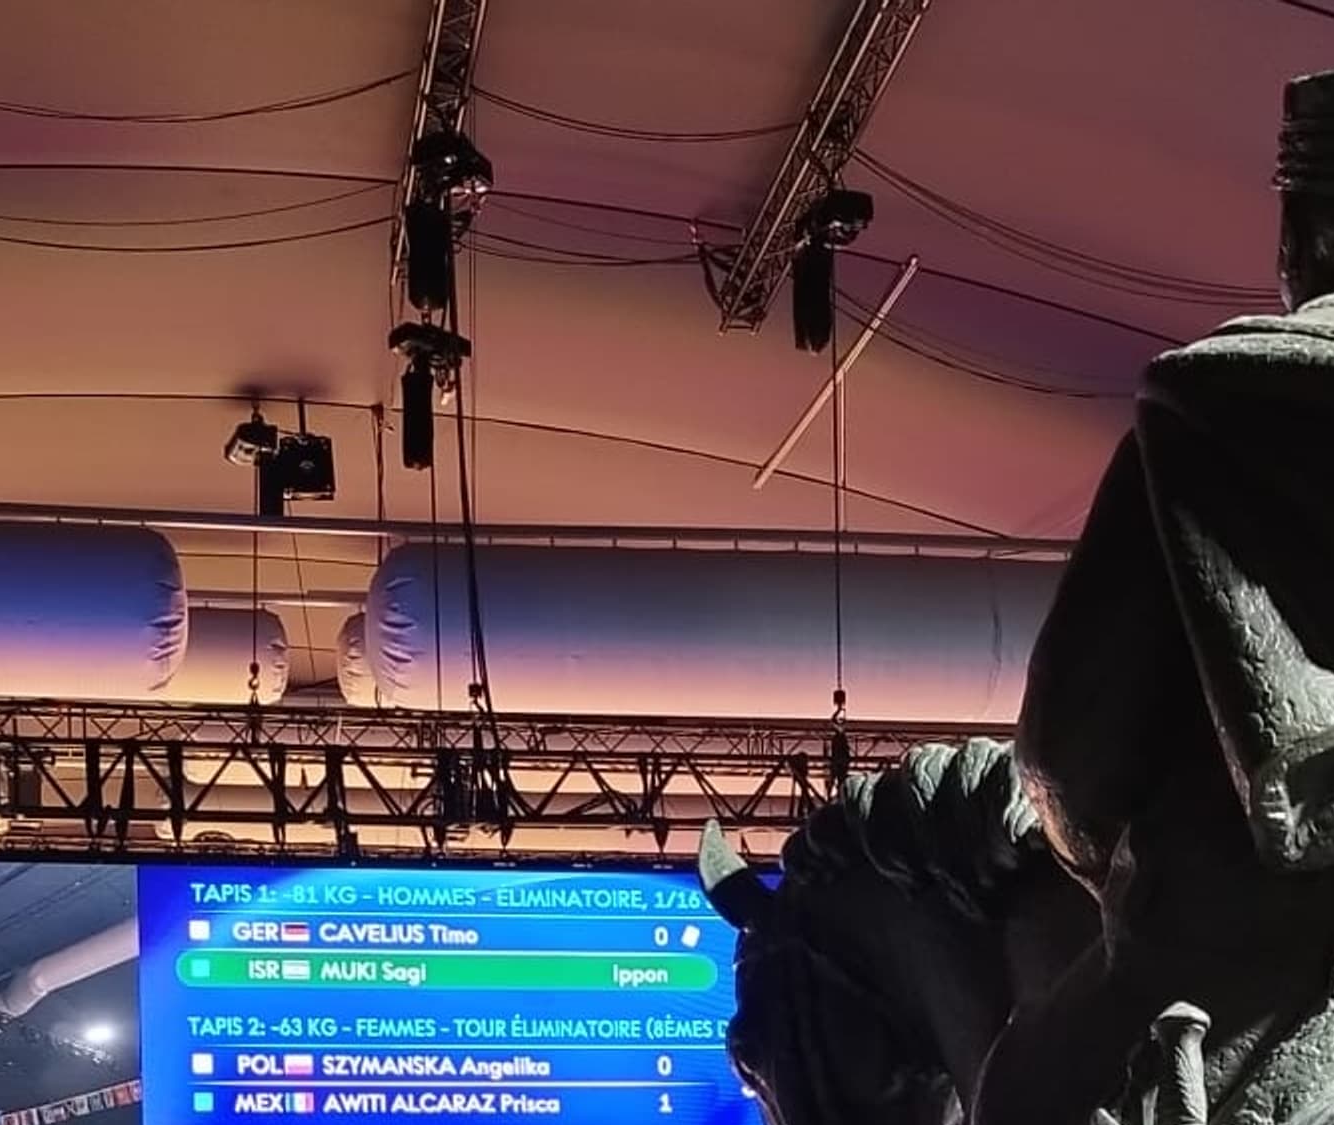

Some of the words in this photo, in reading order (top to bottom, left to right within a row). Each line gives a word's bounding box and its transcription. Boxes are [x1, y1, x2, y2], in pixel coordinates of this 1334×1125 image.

[190, 883, 252, 903] TAPIS
[258, 885, 276, 903] 1:
[283, 885, 317, 904] -81
[324, 886, 357, 905] KG
[378, 886, 476, 906] HOMMES
[654, 889, 701, 909] 1/16
[232, 921, 279, 942] GER
[318, 922, 425, 943] CAVELIUS
[428, 925, 479, 944] Timo
[654, 926, 668, 946] 0
[248, 959, 280, 979] ISR
[320, 961, 377, 981] MUKI
[381, 961, 427, 987] Sagi
[612, 963, 669, 988] Ippon
[187, 1016, 243, 1036] TAPIS
[247, 1017, 266, 1036] 2:
[271, 1018, 303, 1037] -63
[307, 1018, 338, 1038] KG
[356, 1018, 437, 1038] FEMMES
[453, 1018, 506, 1038] TOUR
[511, 1013, 641, 1038] ÉLIMINATOIRE
[237, 1054, 283, 1075] POL
[322, 1055, 456, 1076] SZYMANSKA
[459, 1056, 550, 1080] Angelika
[657, 1056, 672, 1076] 0
[234, 1092, 284, 1113] MEX
[323, 1093, 386, 1113] AWITI
[390, 1093, 496, 1113] ALCARAZ
[500, 1094, 561, 1114] Prisca
[659, 1093, 673, 1113] 1
